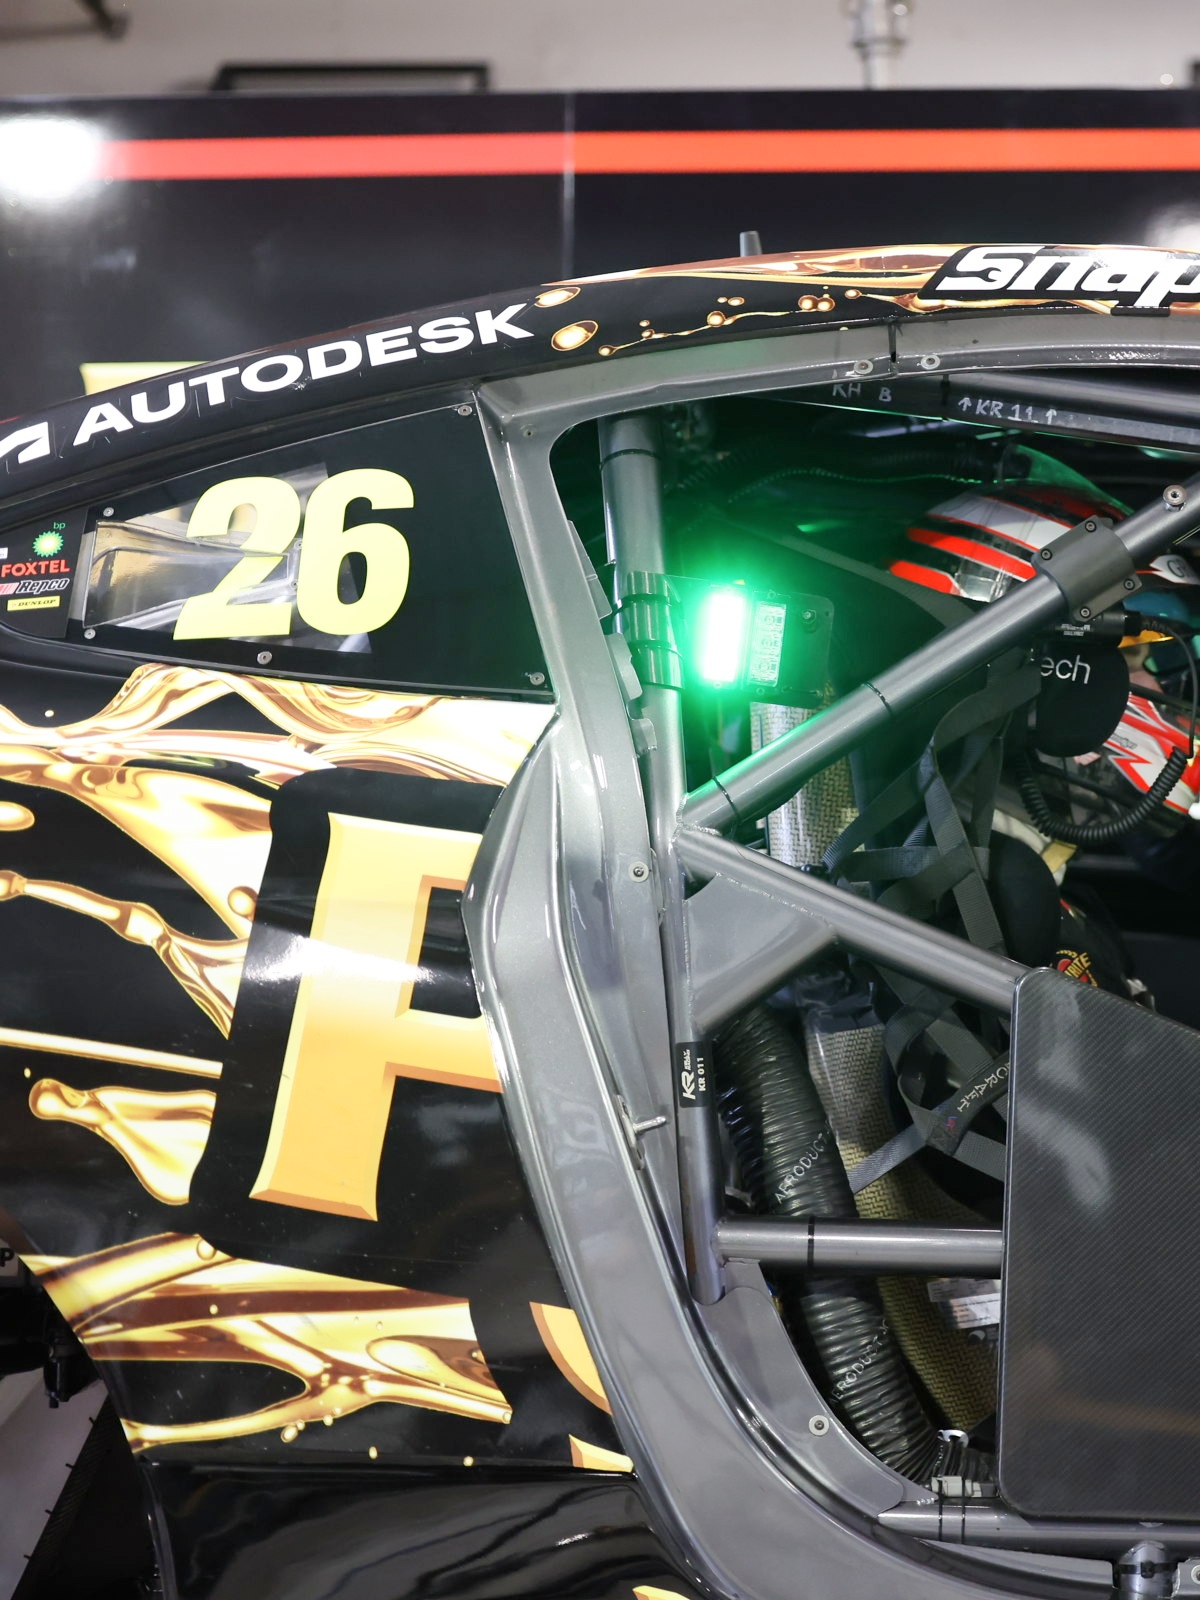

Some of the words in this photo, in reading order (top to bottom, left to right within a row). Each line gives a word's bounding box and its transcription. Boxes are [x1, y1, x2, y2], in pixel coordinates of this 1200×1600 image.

[72, 302, 535, 446] AUTODESK
[975, 398, 1004, 419] KR
[52, 521, 67, 531] bp
[173, 467, 415, 641] 26
[1, 559, 72, 578] FOXTEL
[17, 599, 57, 607] DUNLOP
[696, 1057, 705, 1075] 011
[698, 1077, 706, 1092] KR
